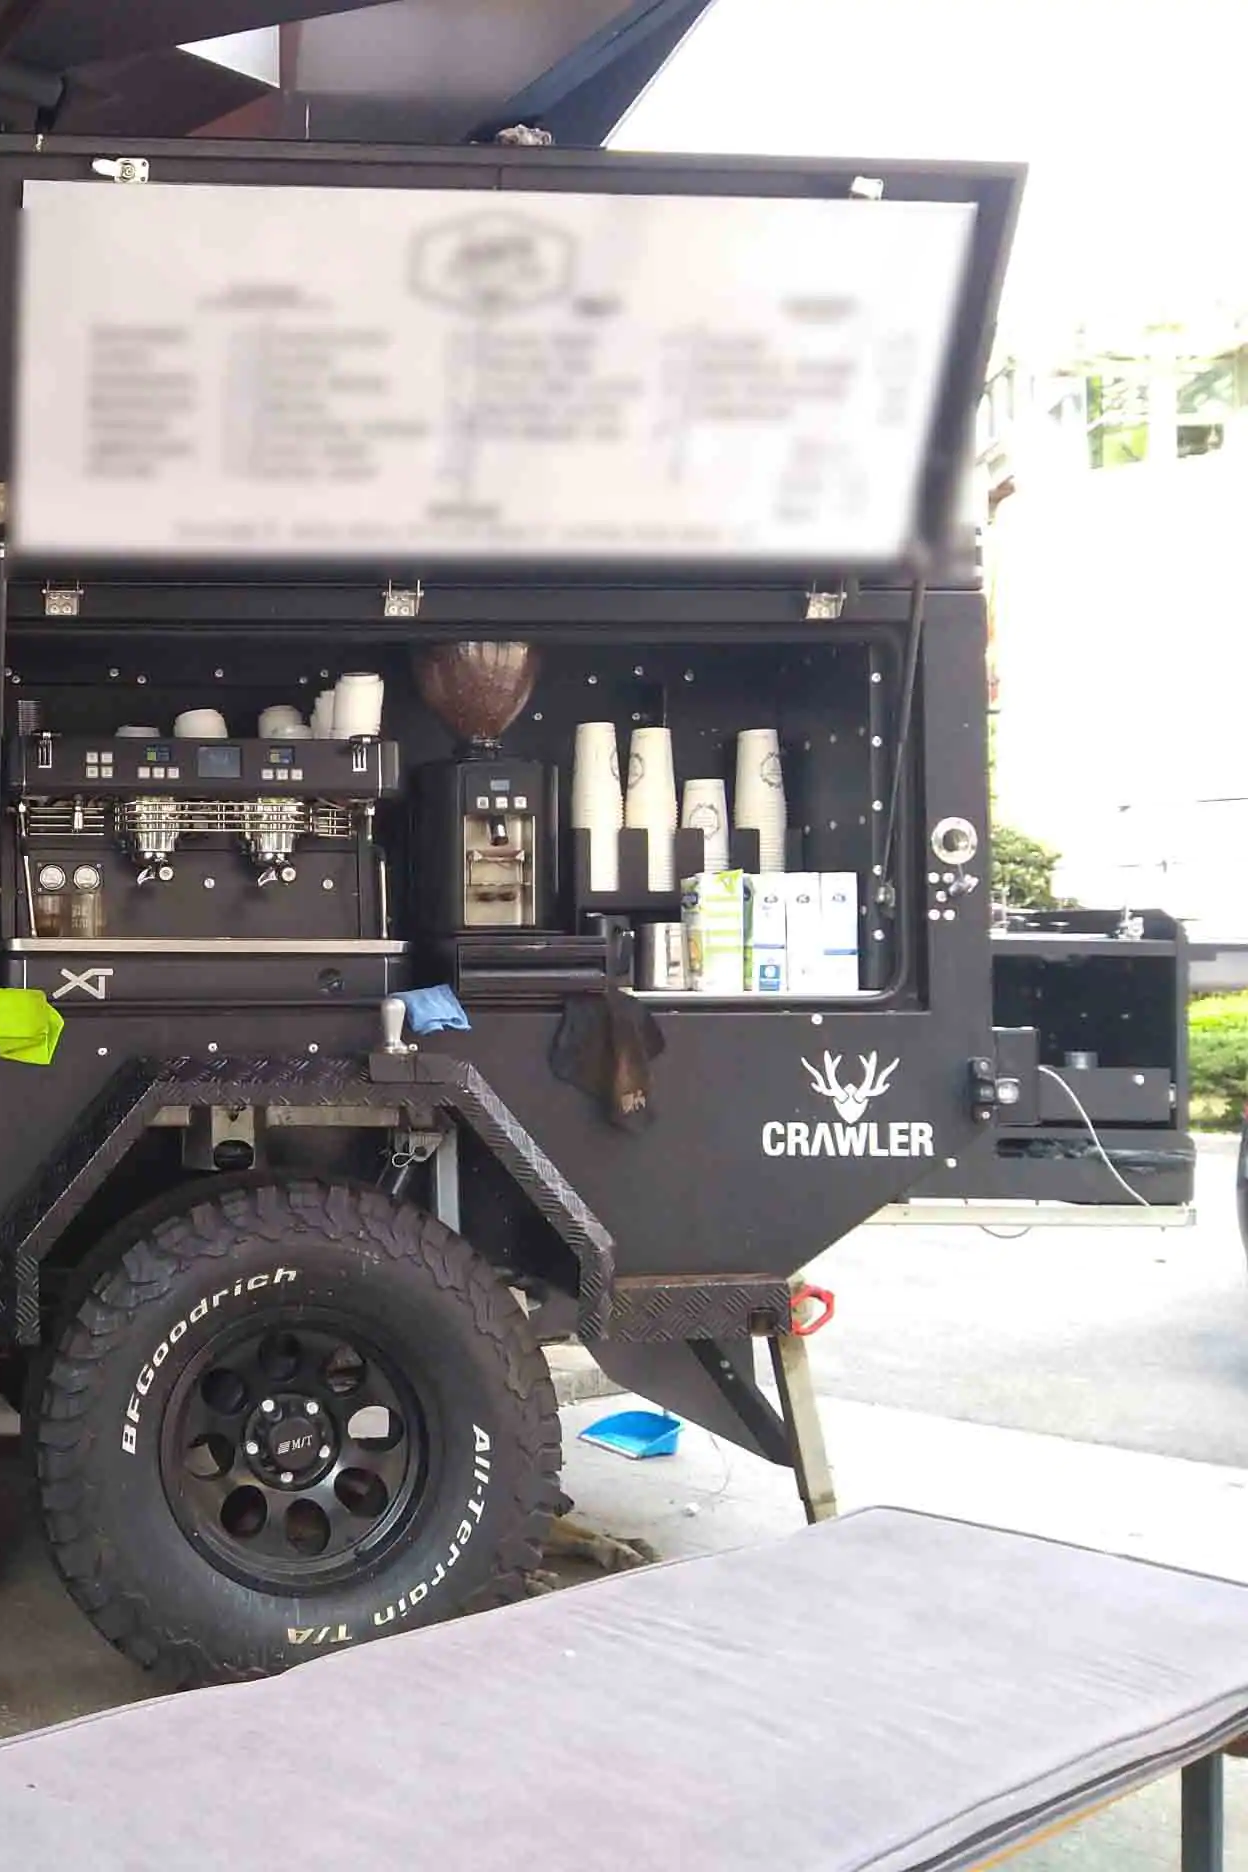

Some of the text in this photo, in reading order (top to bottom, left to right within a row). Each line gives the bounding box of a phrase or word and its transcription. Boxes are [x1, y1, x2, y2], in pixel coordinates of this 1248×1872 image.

[761, 1120, 935, 1157] CRAWLER
[121, 1267, 298, 1455] BFGoodrich
[292, 1434, 313, 1451] M/T
[287, 1423, 491, 1645] All-Terrain T/A
